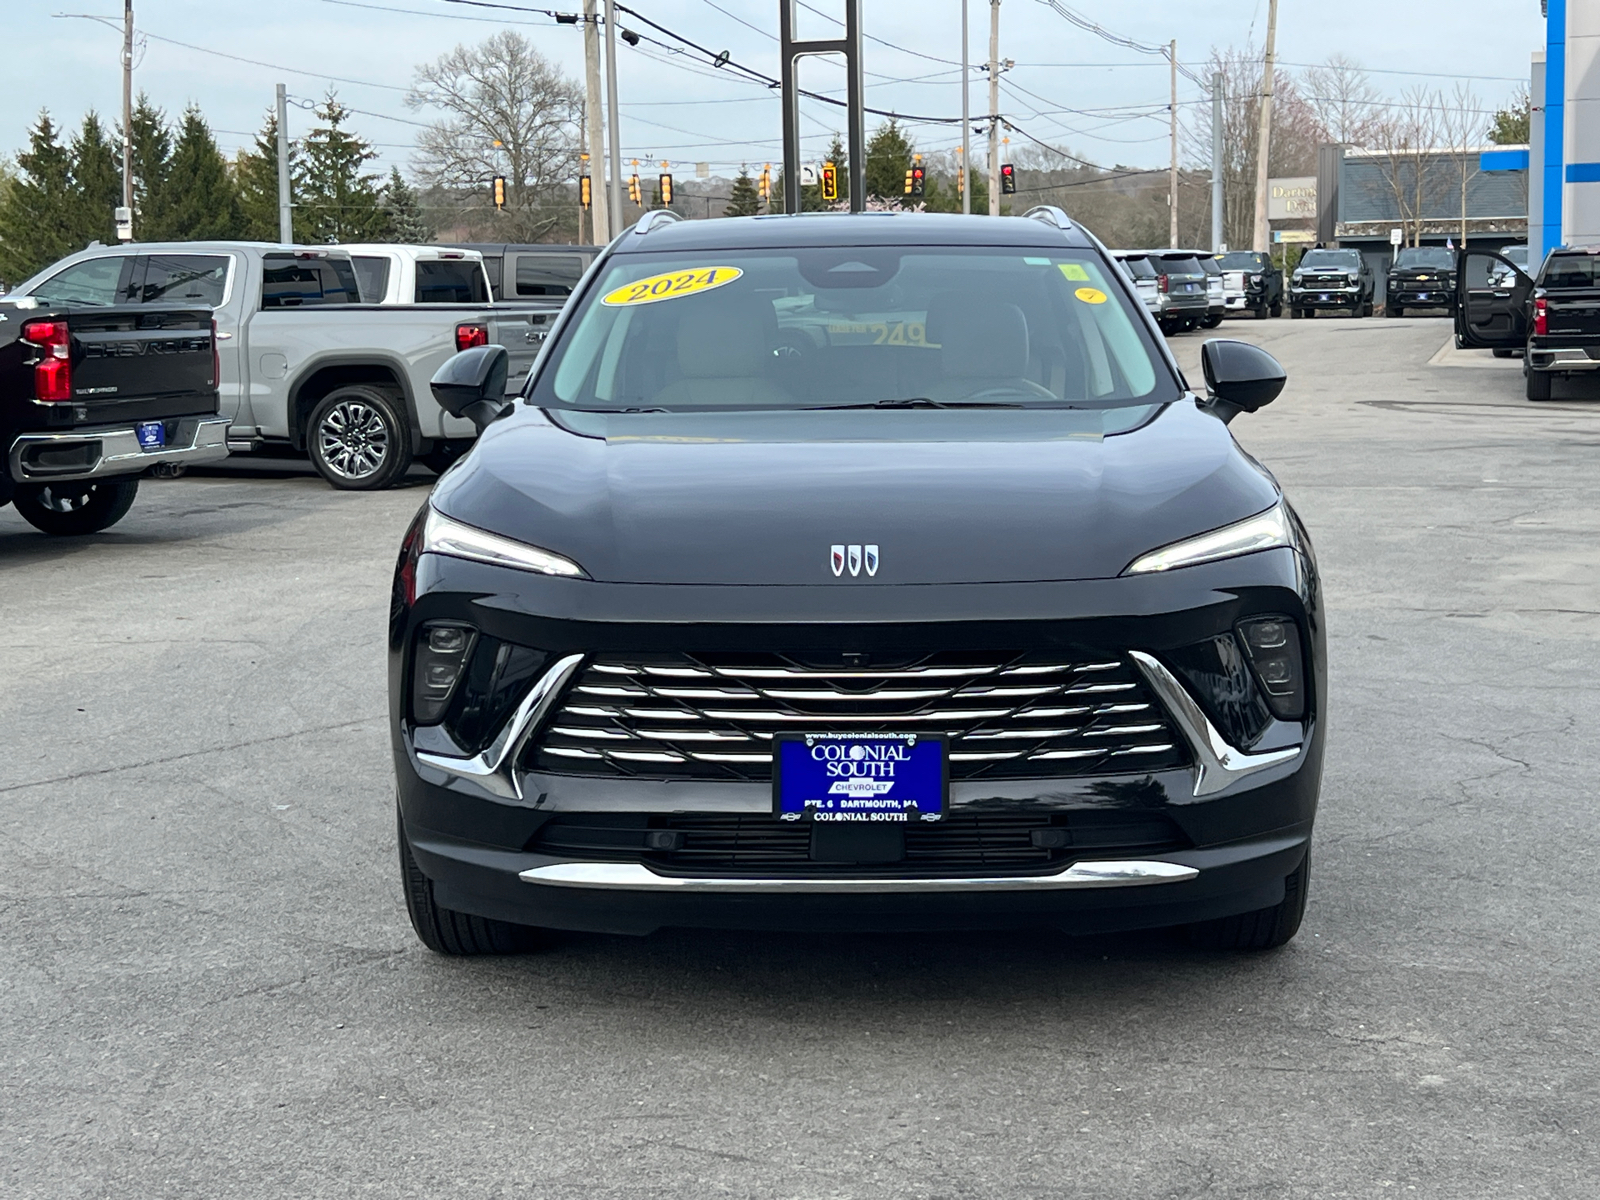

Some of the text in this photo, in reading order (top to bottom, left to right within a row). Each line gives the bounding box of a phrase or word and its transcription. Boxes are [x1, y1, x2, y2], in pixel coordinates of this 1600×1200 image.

[627, 269, 718, 302] 2024
[86, 339, 210, 358] CHEVROLET
[811, 744, 911, 761] COLONIAL
[826, 761, 896, 777] SOUTH
[835, 783, 887, 791] CHEVROLET
[840, 799, 902, 810] DARTMOUTH,
[813, 812, 908, 821] COLONIAL SOUTH
